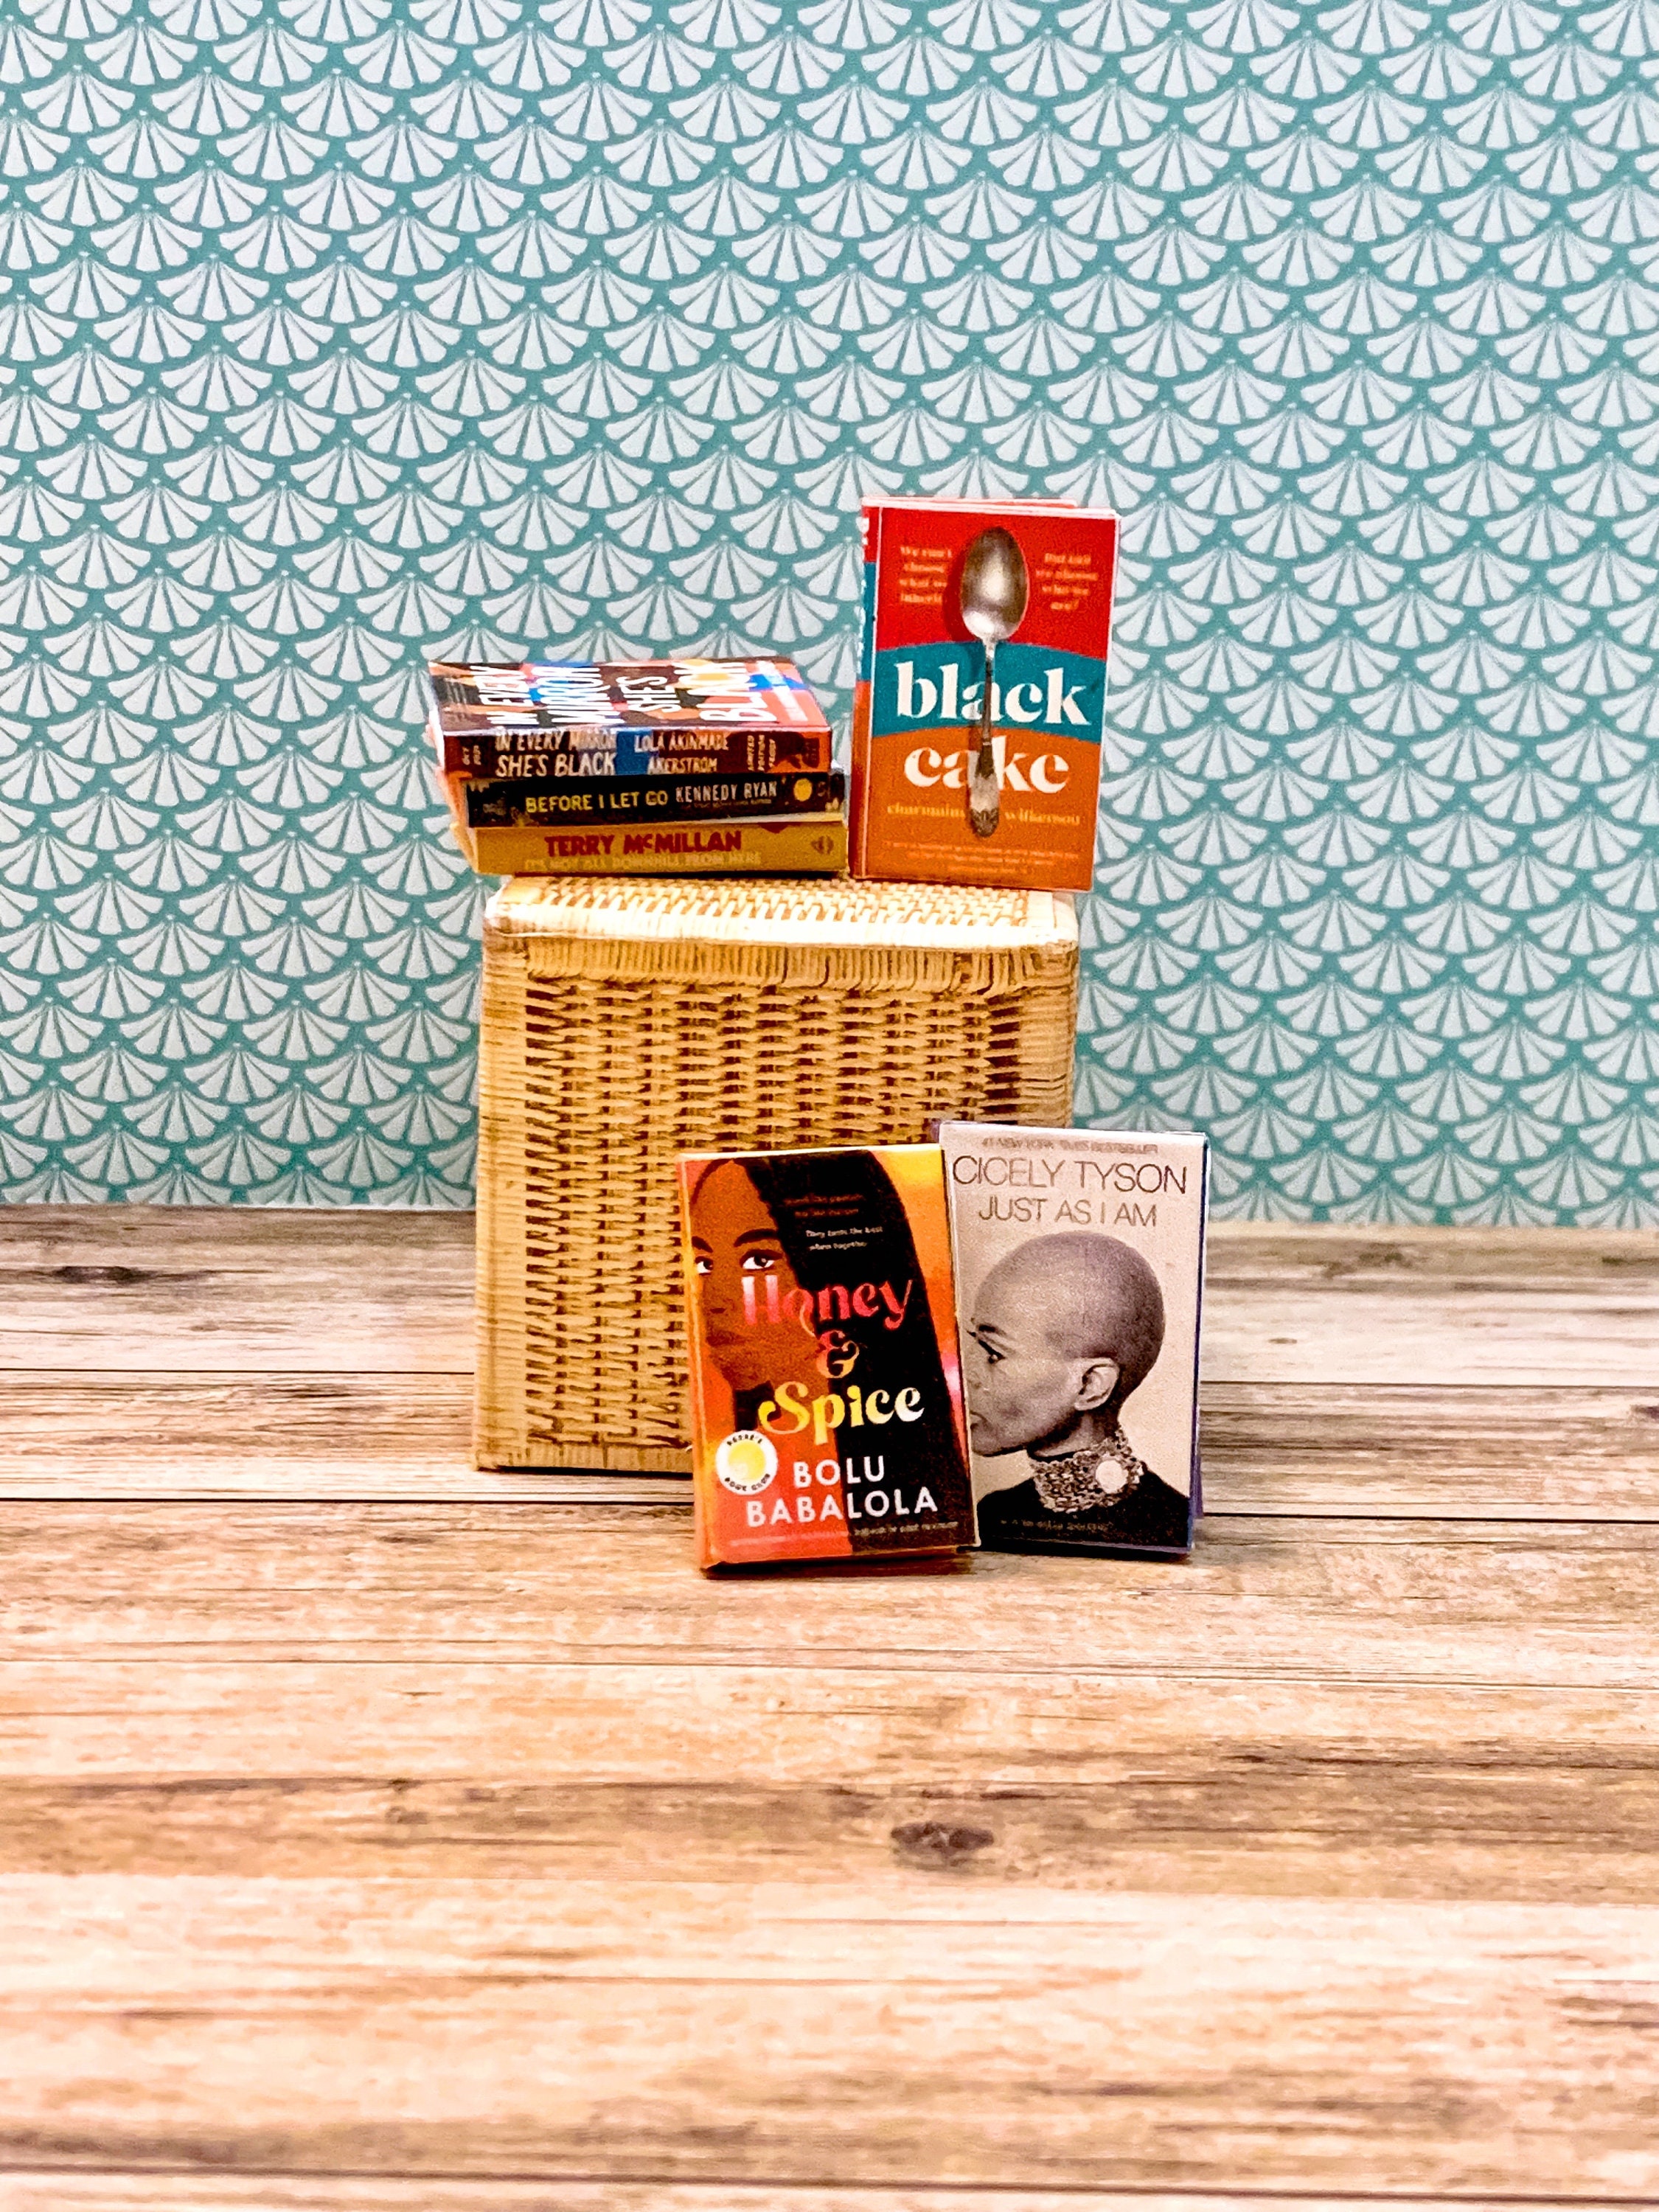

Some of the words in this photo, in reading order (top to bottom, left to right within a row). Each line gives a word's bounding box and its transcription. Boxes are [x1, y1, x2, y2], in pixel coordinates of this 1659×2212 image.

[894, 661, 1091, 725] black
[516, 730, 565, 751] EVERY
[495, 754, 548, 777] SHE'S
[554, 751, 617, 777] BLACK
[904, 736, 1069, 793] cake
[526, 795, 592, 813] BEFORE
[599, 794, 604, 808] I
[610, 792, 639, 808] LET
[646, 790, 668, 805] GO
[676, 785, 737, 802] KENNEDY
[744, 782, 776, 799] RYAN
[544, 835, 614, 857] TERRY
[953, 1155, 1065, 1187] CICELY
[1074, 1161, 1187, 1194] TYSON
[979, 1195, 1048, 1222] JUST
[1055, 1200, 1091, 1225] AS
[1101, 1202, 1105, 1224] I
[1114, 1202, 1157, 1227] AM
[741, 1275, 913, 1336] Honey
[816, 1330, 860, 1379] &
[758, 1381, 925, 1445] Spice
[793, 1455, 885, 1488] BOLU
[746, 1486, 938, 1528] BABALOLA
